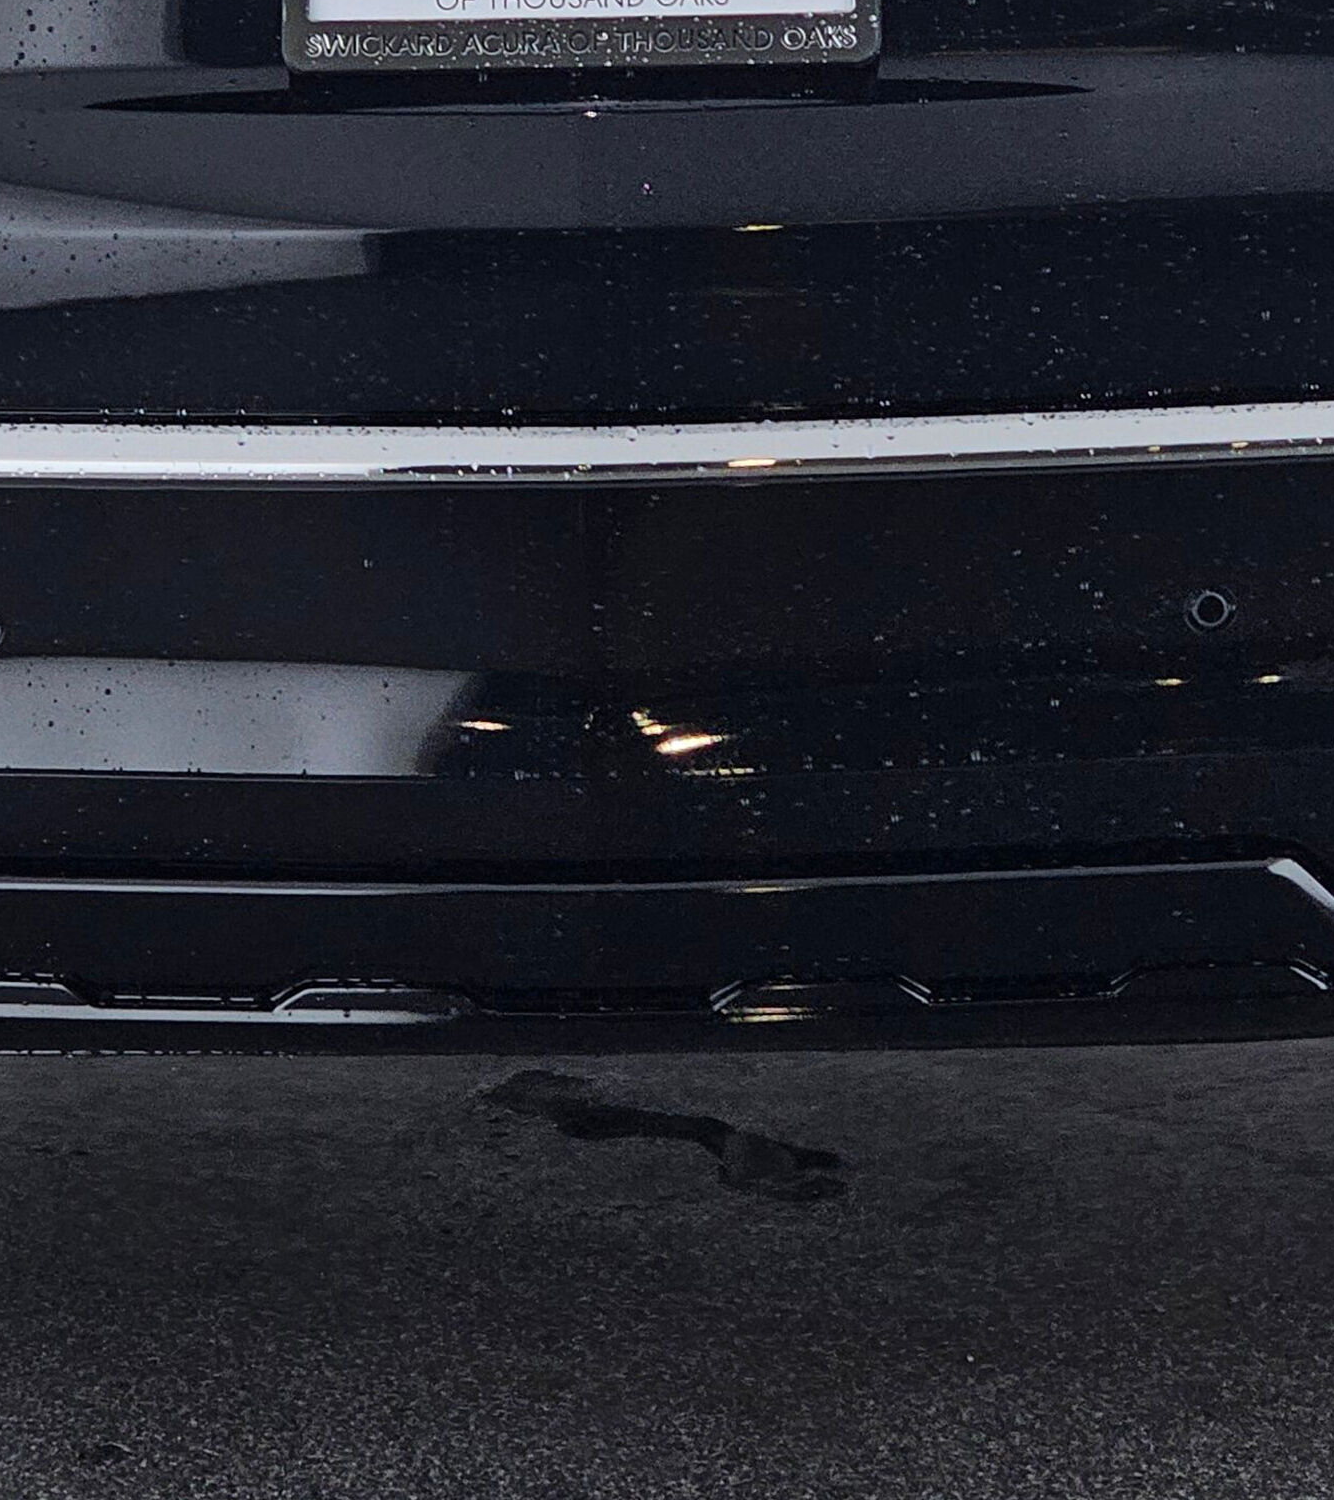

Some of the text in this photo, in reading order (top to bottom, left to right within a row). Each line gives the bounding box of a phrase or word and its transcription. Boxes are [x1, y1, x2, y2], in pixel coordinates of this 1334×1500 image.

[305, 24, 857, 58] SWICKARD ACURA OF THOUSAND OAKS
